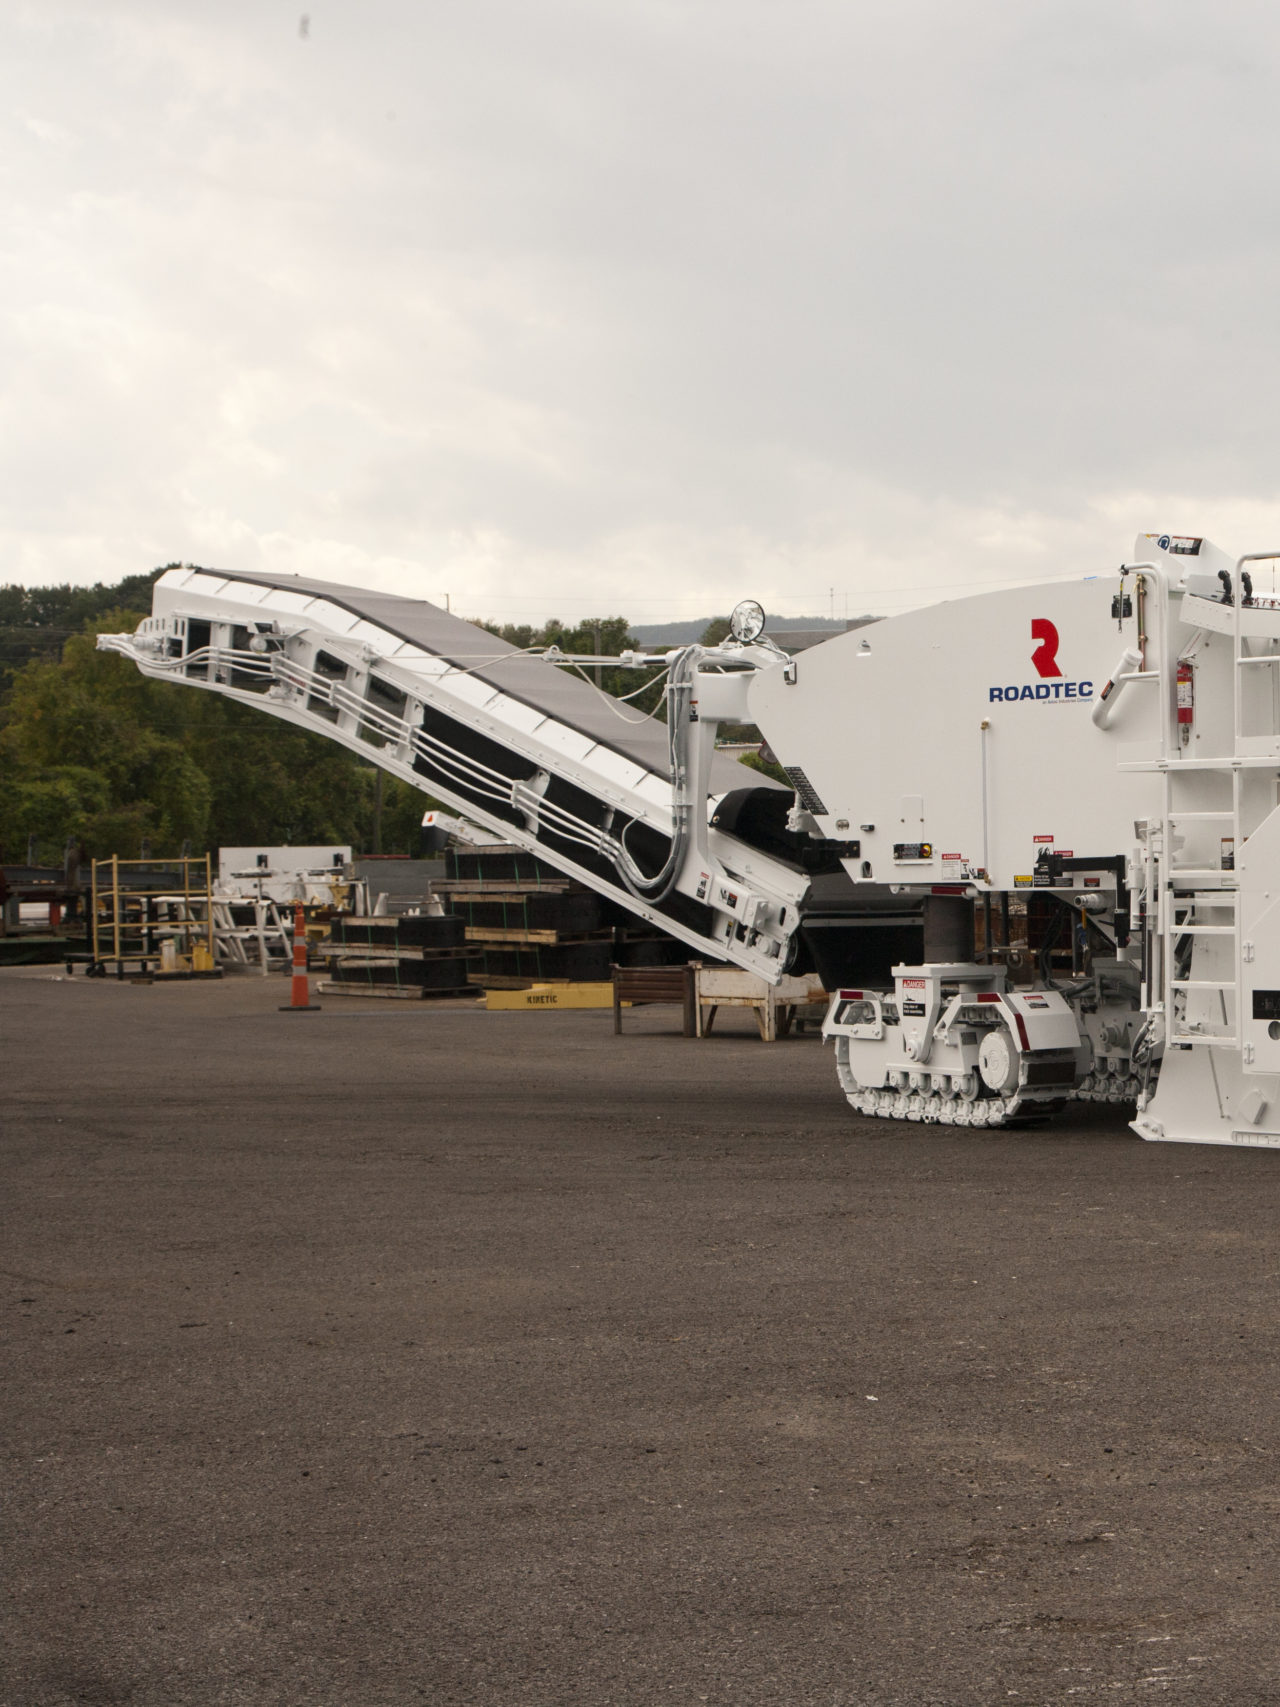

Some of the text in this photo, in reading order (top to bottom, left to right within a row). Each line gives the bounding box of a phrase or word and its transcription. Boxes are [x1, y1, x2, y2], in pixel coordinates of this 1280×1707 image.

[989, 681, 1093, 702] ROADTEC
[907, 980, 926, 988] DANGER
[527, 995, 558, 1004] KINETIC
